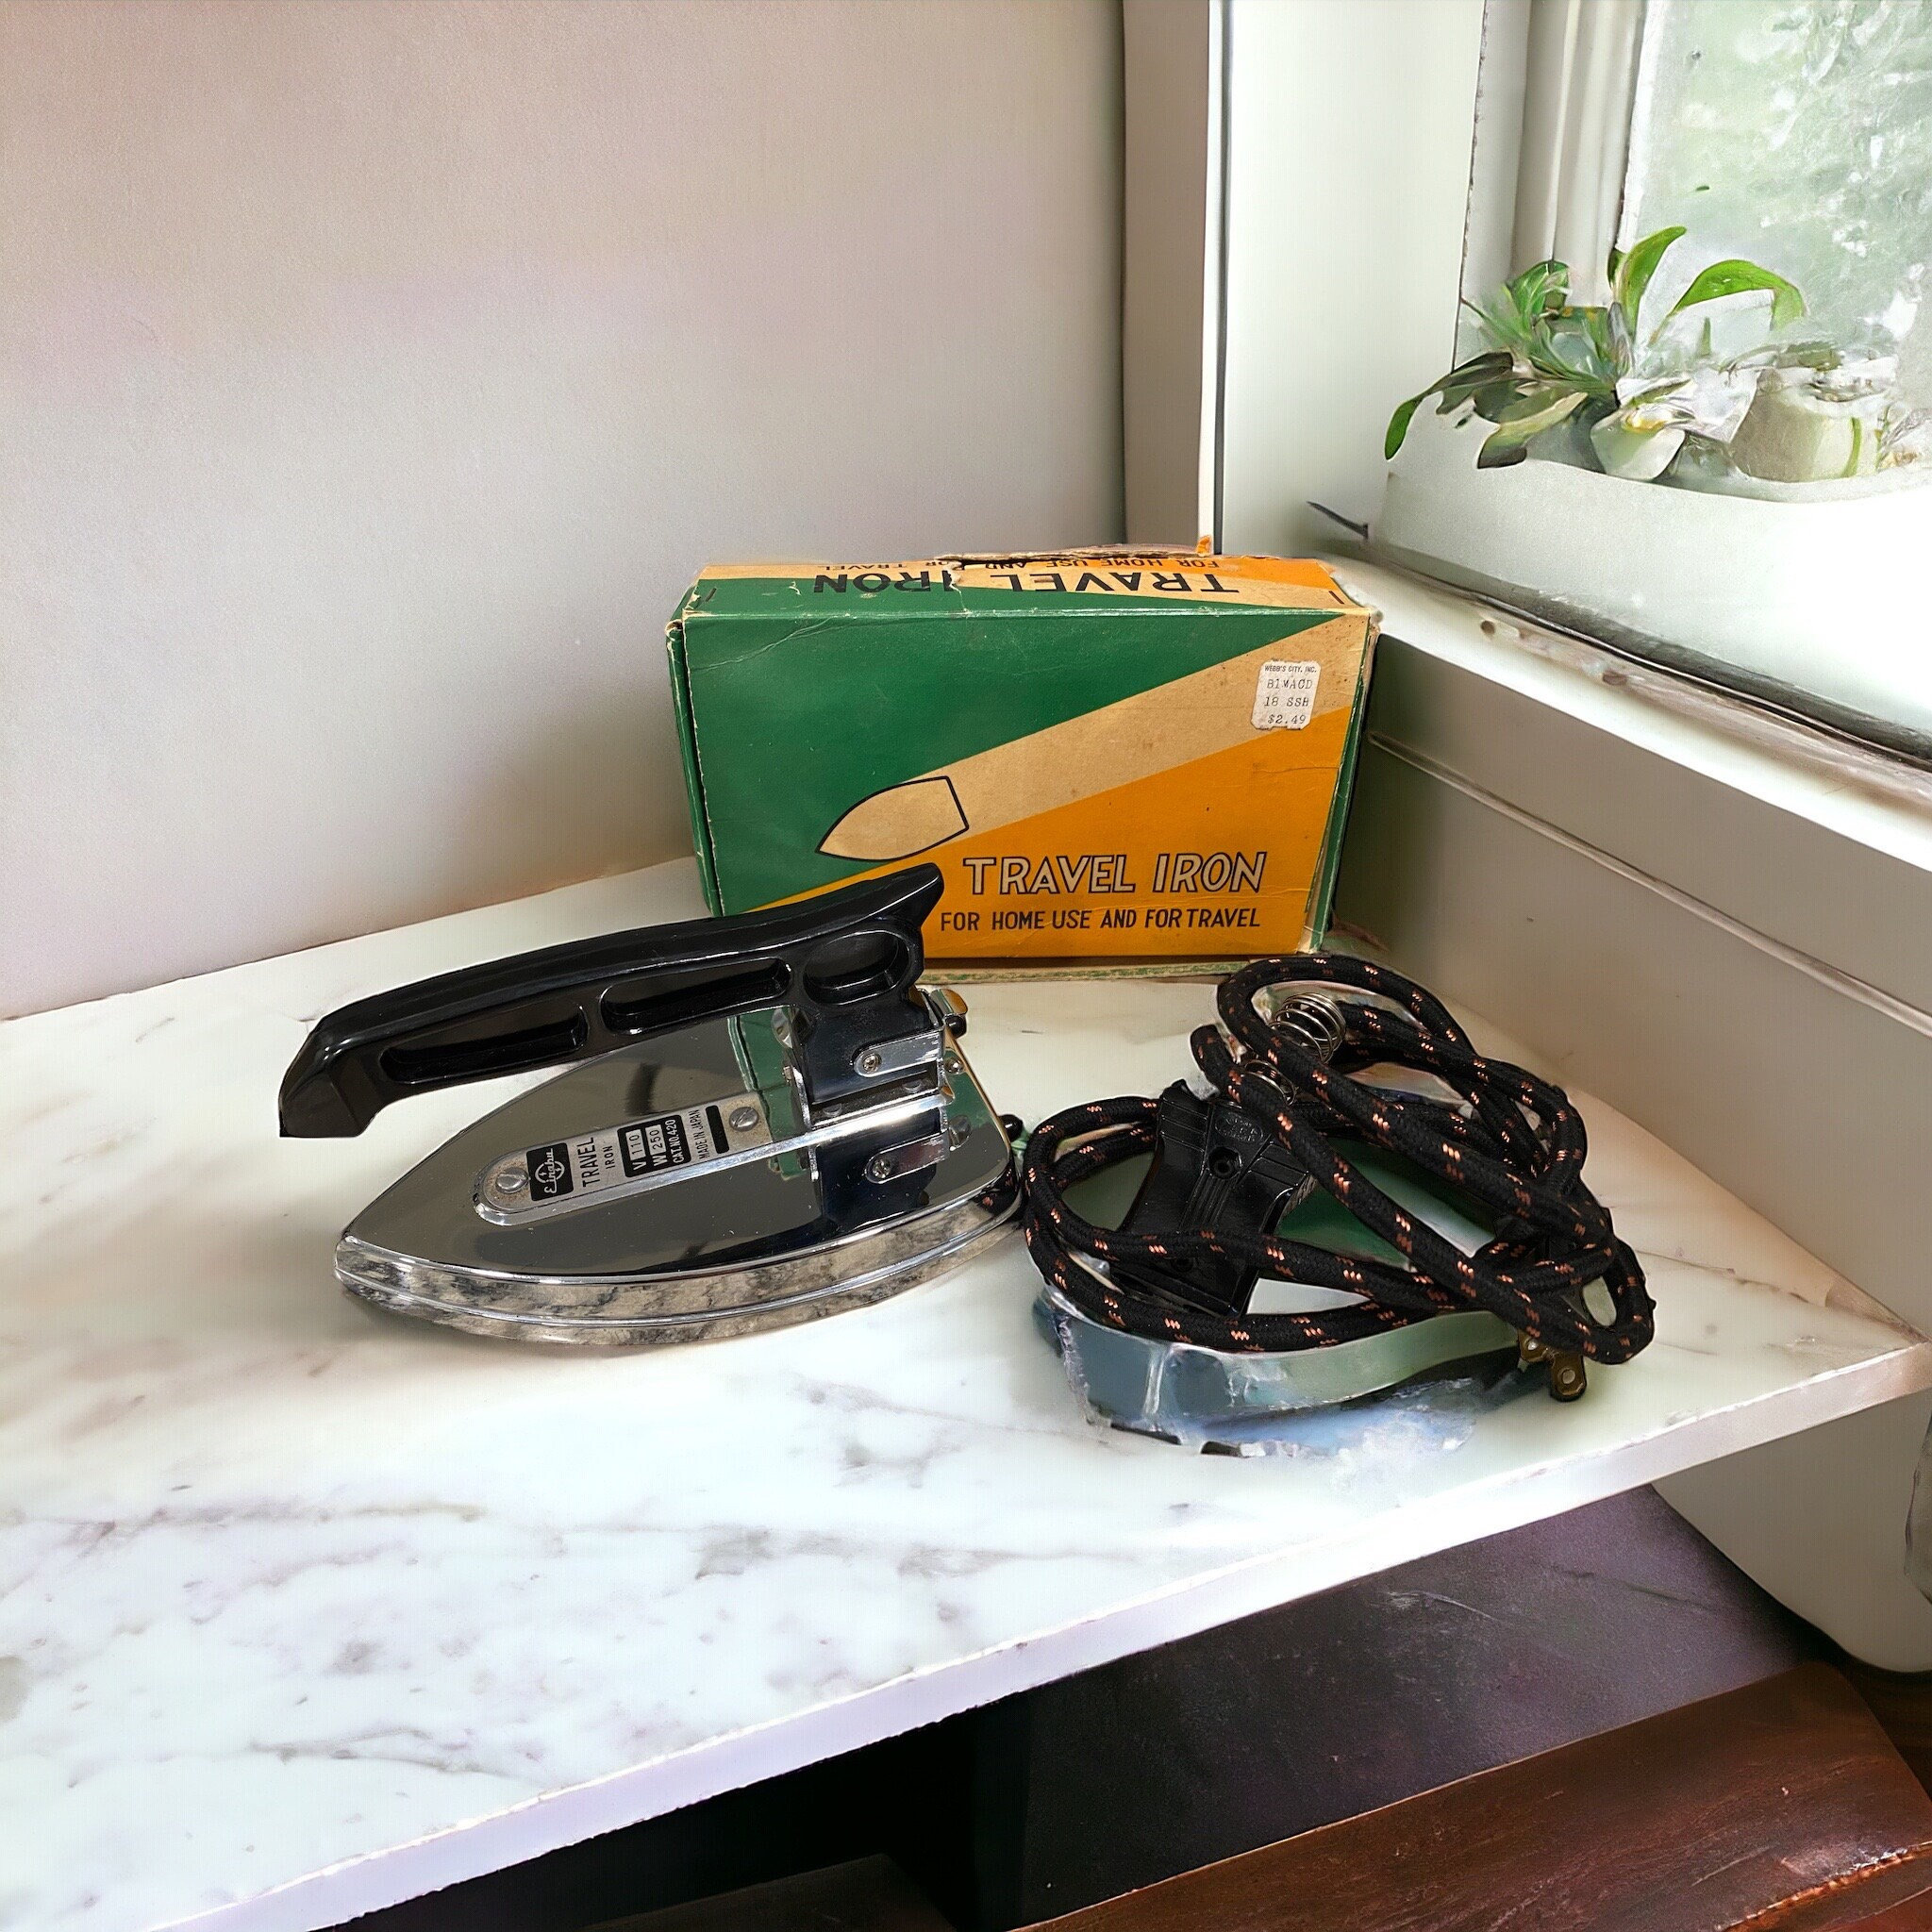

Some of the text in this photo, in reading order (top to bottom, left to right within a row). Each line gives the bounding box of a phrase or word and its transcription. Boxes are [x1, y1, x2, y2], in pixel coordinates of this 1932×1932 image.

[1101, 558, 1163, 567] HOME
[813, 570, 1240, 592] TRAVEL IRON
[1264, 696, 1278, 707] 18
[1267, 714, 1306, 724] $2.49
[963, 851, 1267, 895] TRAVEL IRON
[941, 908, 1260, 931] FOR HOME USE AND FOR TRAVEL
[689, 1109, 711, 1159] MADE IN JAPAN
[603, 1145, 614, 1170] IRON
[628, 1134, 647, 1171] V 110
[649, 1129, 668, 1167] W 250
[576, 1137, 601, 1188] TRAVEL
